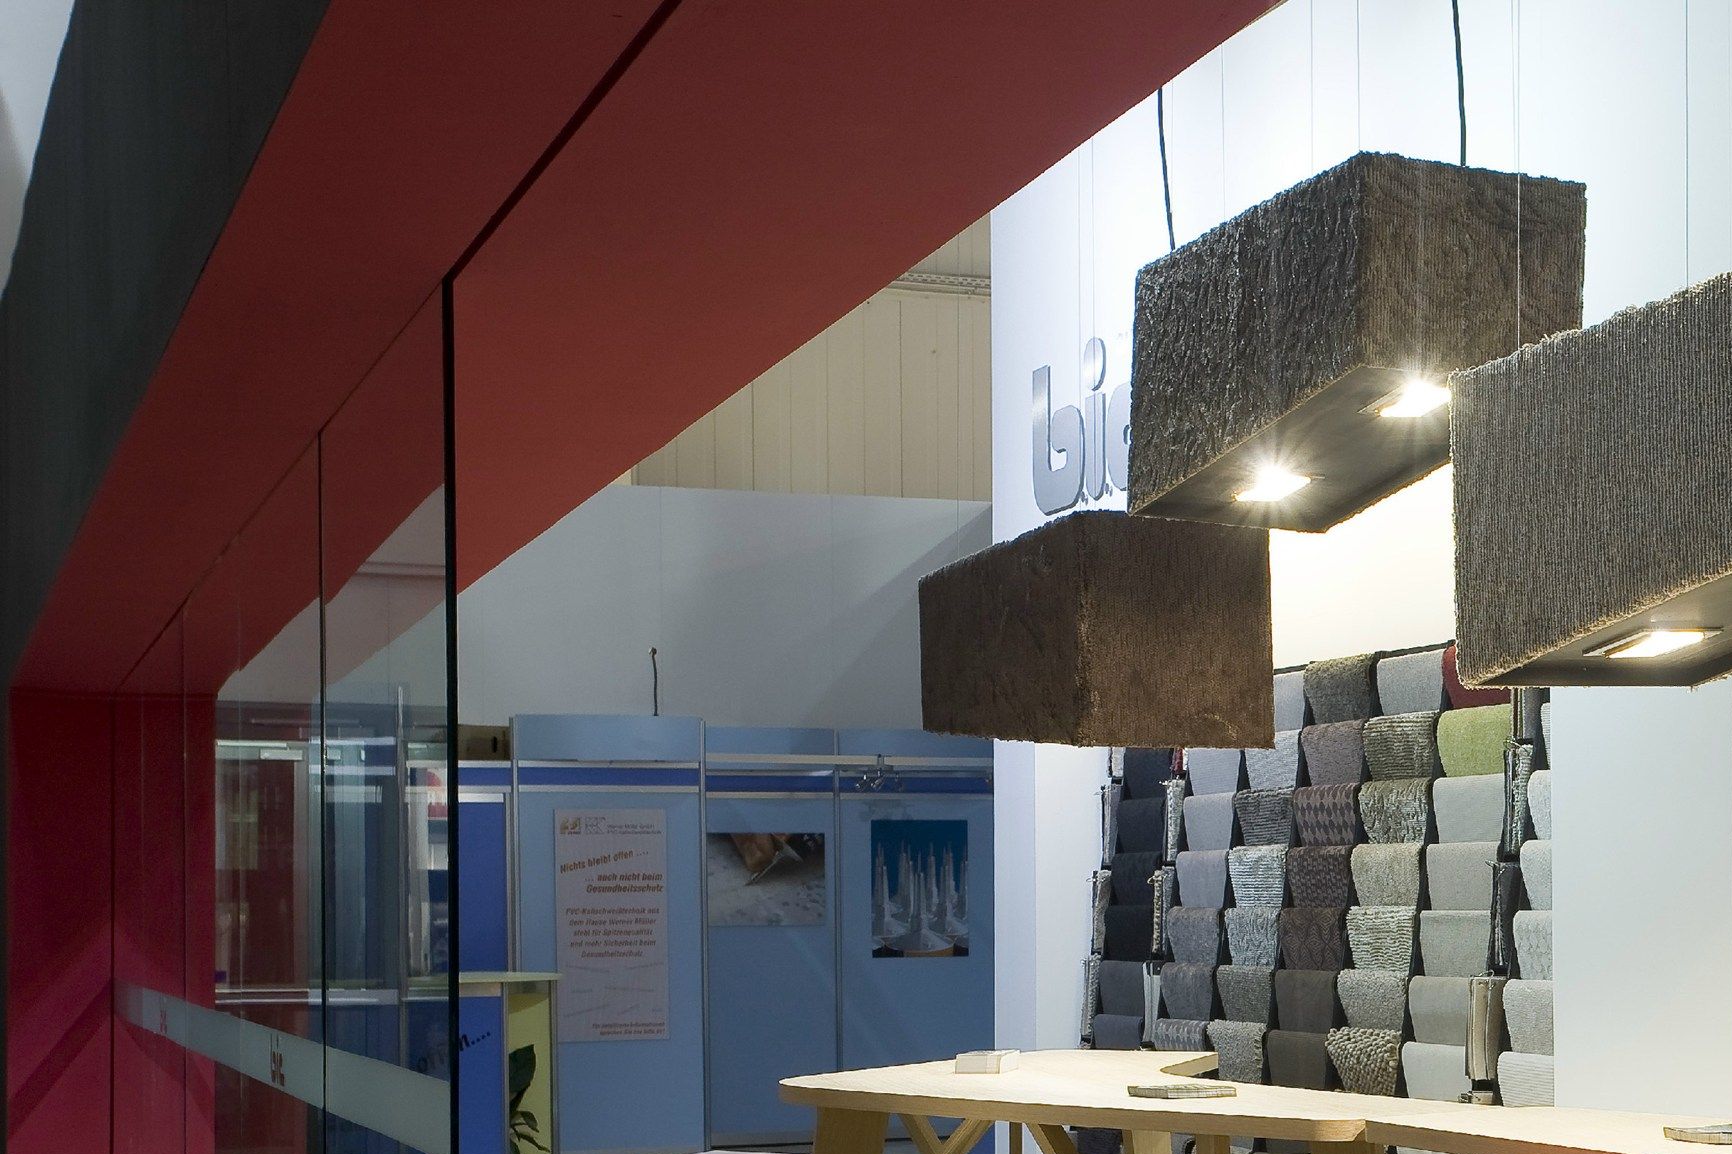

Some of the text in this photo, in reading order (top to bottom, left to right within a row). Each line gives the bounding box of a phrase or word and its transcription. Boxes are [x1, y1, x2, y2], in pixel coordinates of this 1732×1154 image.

[560, 860, 586, 874] Nichts
[588, 854, 611, 867] bleibt
[613, 849, 634, 862] offen
[597, 873, 617, 882] auch
[619, 872, 640, 882] nicht
[642, 872, 663, 882] beim
[586, 883, 664, 894] Gesundheitsschutz
